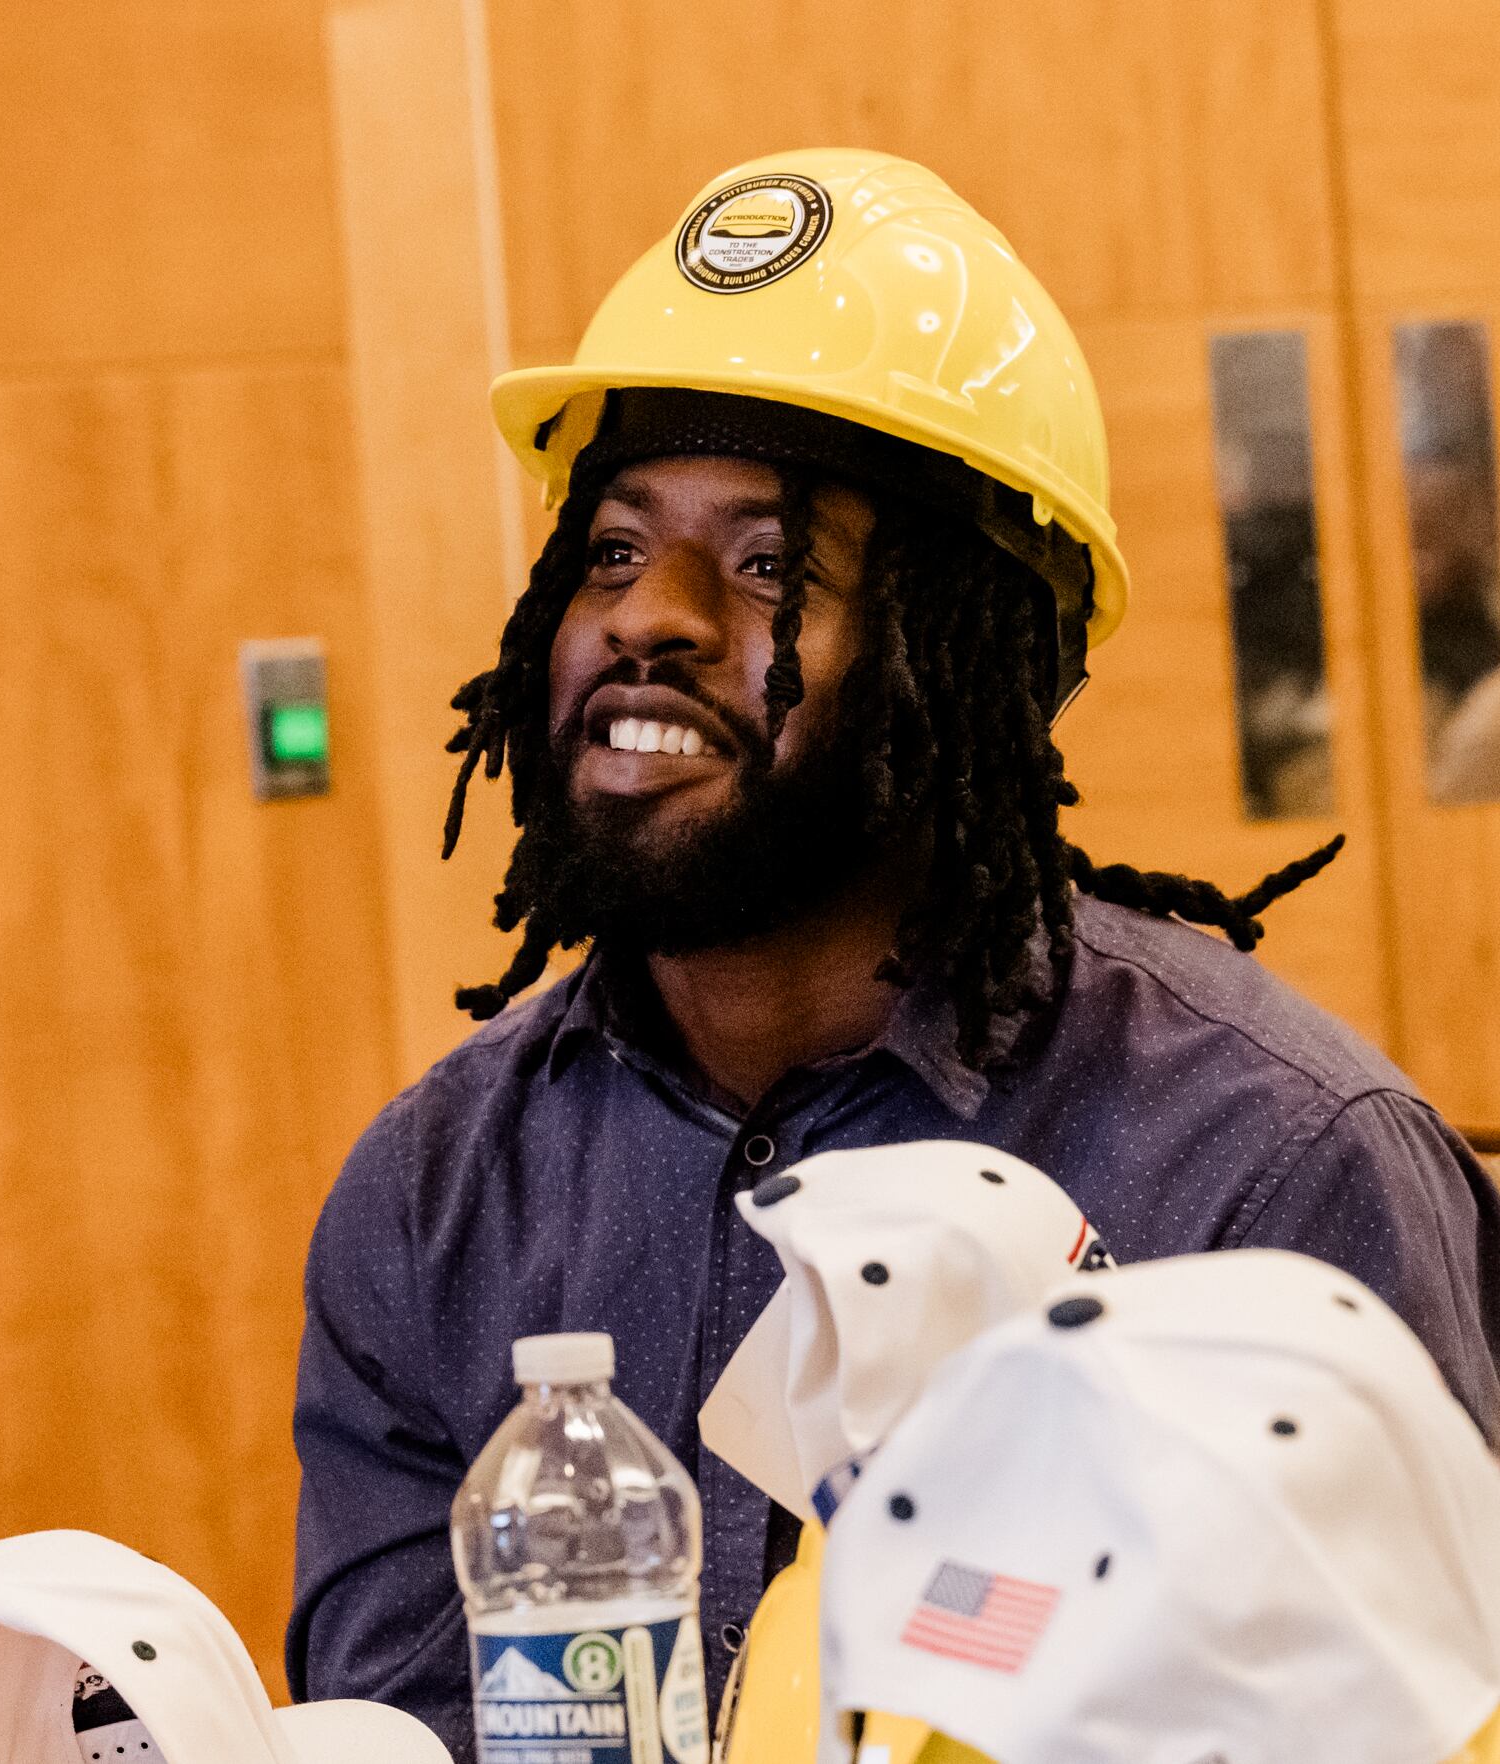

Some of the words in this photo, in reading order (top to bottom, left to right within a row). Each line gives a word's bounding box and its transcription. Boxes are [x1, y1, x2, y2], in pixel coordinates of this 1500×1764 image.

[721, 179, 780, 200] PITTSBURGH
[722, 214, 788, 222] INTRODUCTION
[799, 214, 820, 247] COUNCIL
[687, 211, 708, 257] PITTSBURG
[687, 258, 722, 284] EGIONAL
[768, 246, 803, 273] TRADES
[723, 269, 767, 285] BUILDING
